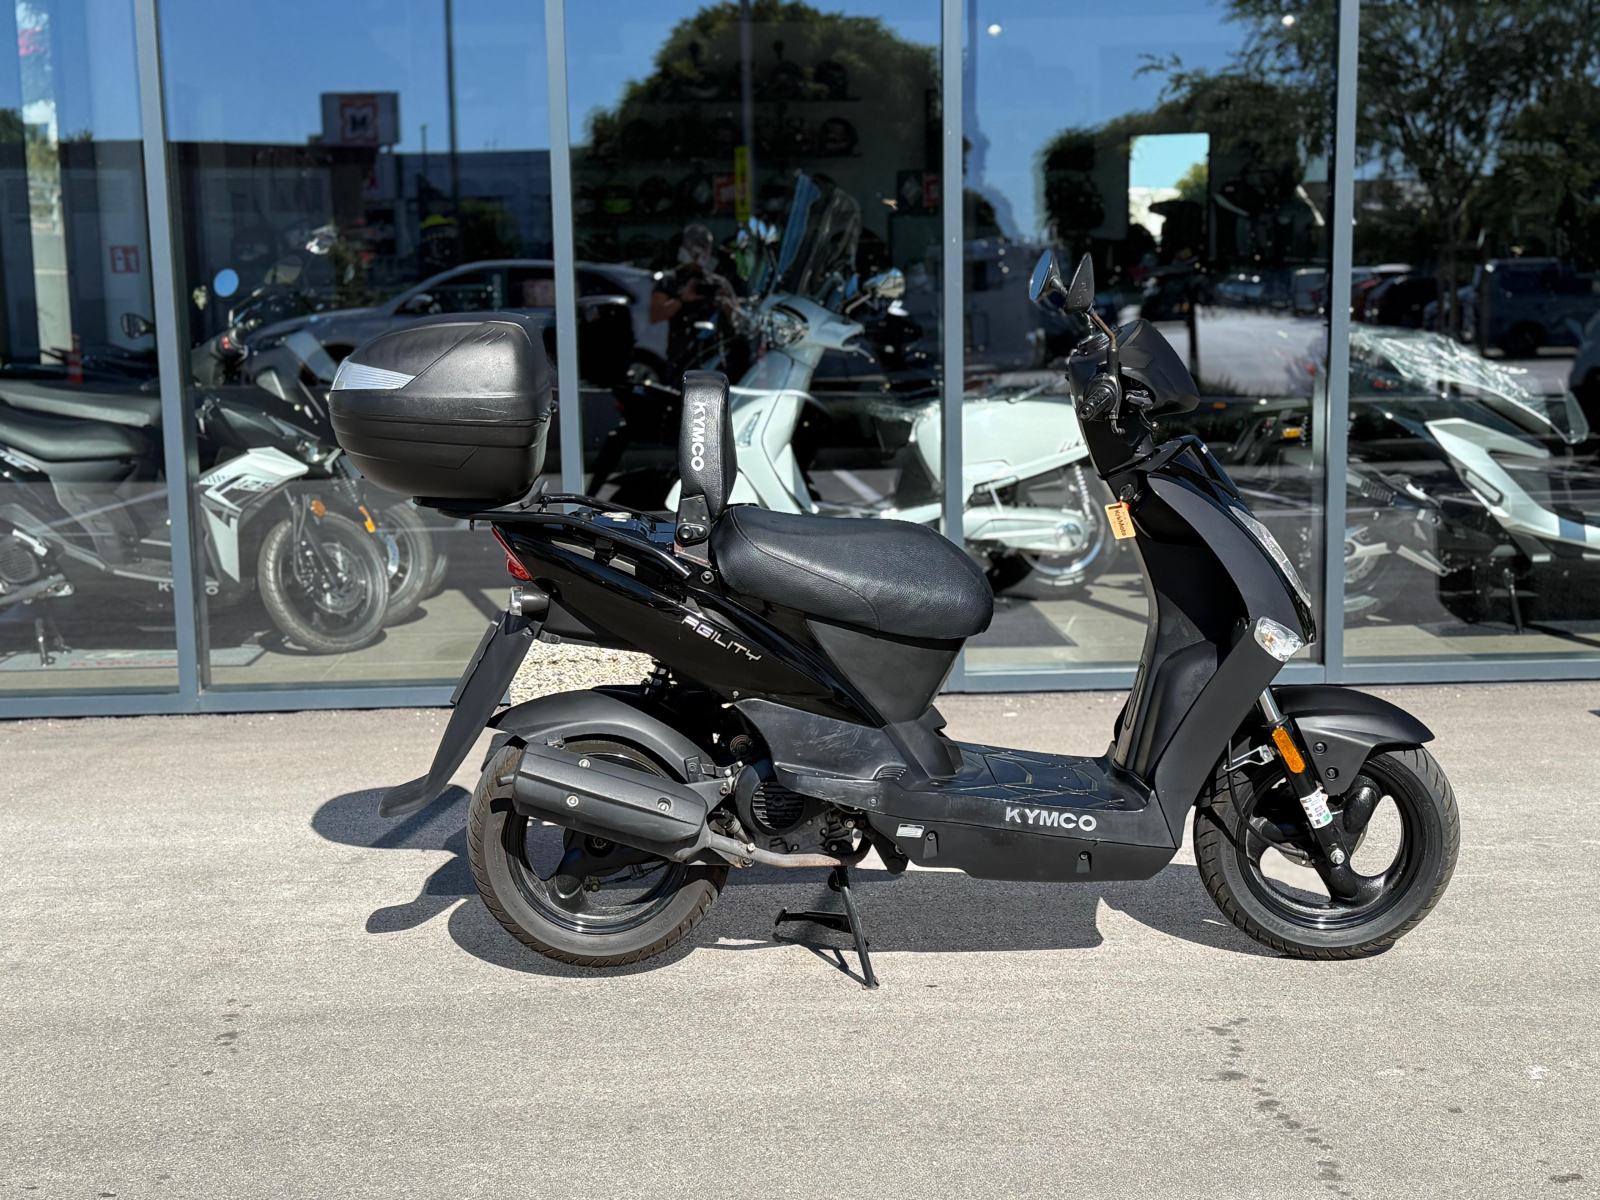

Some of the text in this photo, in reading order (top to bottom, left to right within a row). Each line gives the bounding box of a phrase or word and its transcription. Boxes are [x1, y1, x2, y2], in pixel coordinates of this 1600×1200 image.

[691, 402, 706, 471] KYMCO
[681, 615, 762, 661] AGILITY
[1005, 806, 1098, 832] KYMCO
